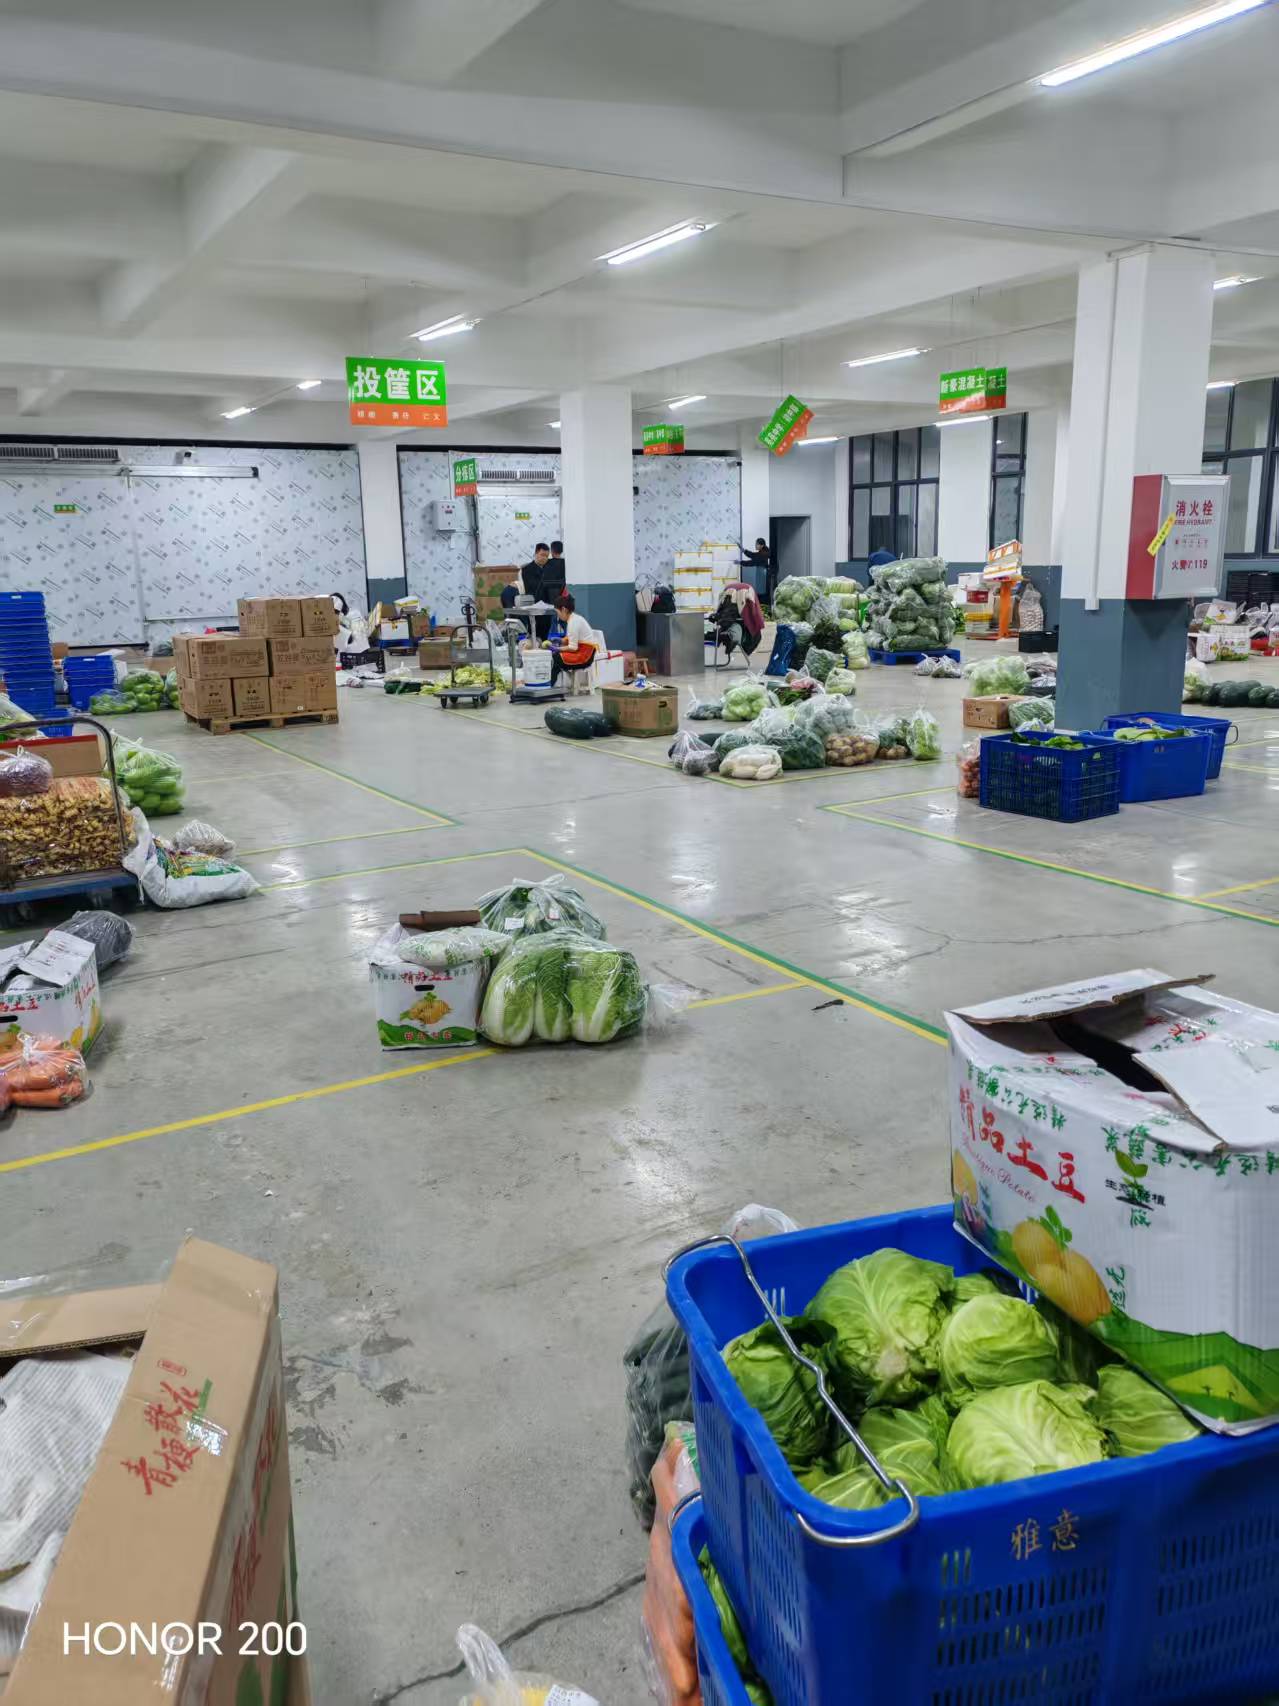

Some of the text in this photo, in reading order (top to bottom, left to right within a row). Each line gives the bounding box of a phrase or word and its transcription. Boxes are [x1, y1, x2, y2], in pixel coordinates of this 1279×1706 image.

[353, 365, 440, 399] 投筐区
[1175, 500, 1213, 517] 消火栓
[1011, 1508, 1080, 1560] 雅意
